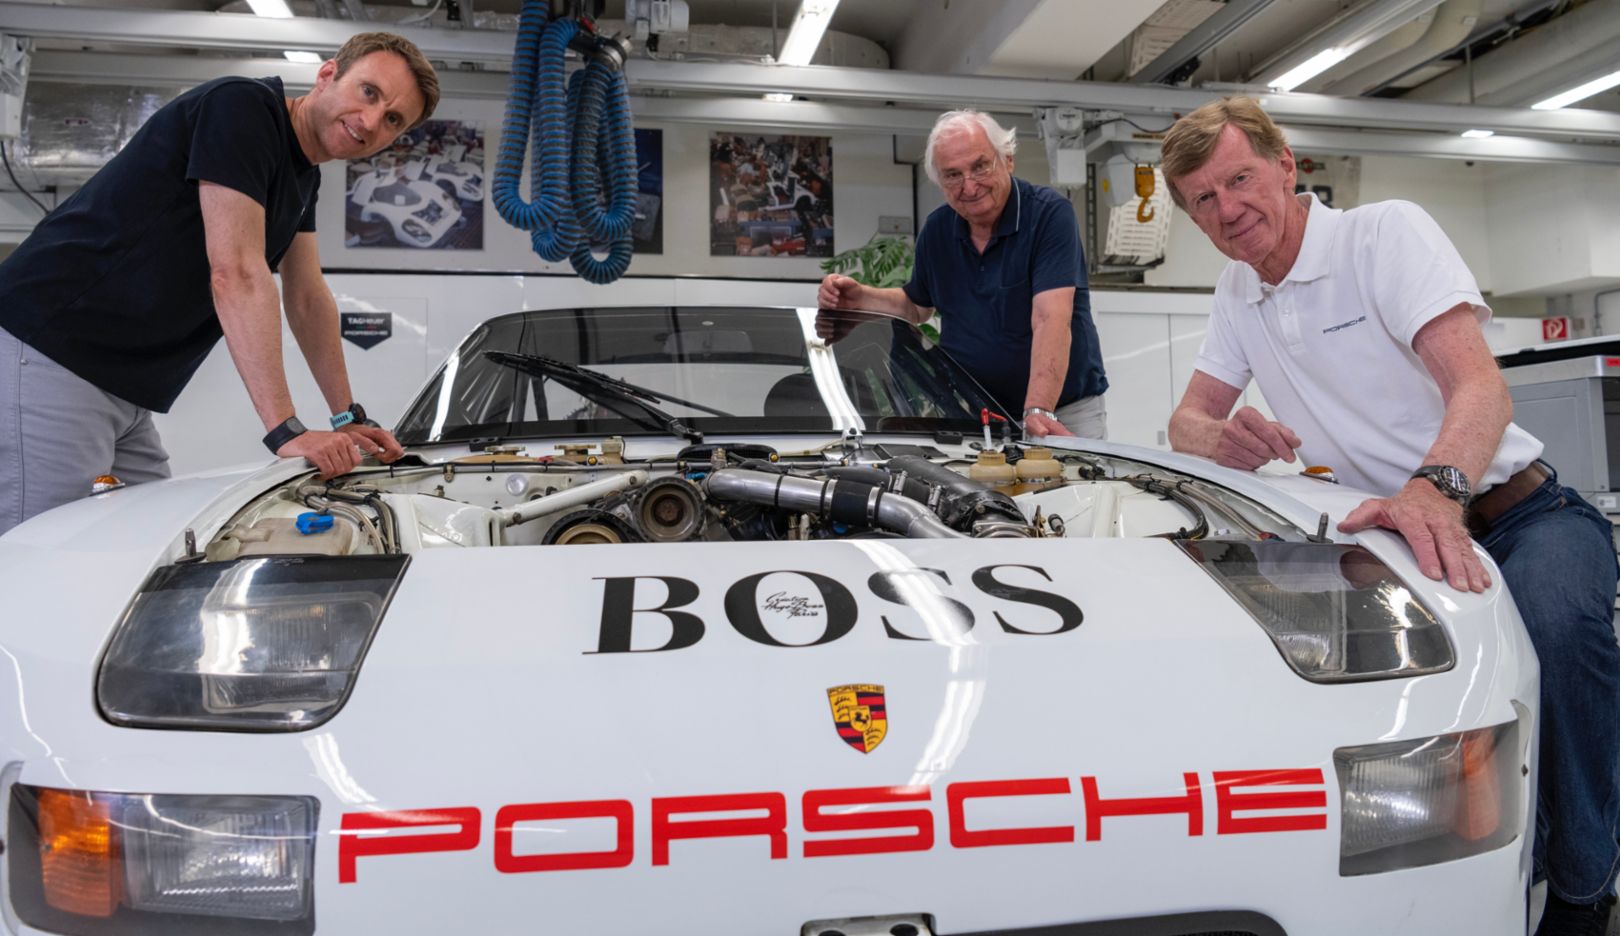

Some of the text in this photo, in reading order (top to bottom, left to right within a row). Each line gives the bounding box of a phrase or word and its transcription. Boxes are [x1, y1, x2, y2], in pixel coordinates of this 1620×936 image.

[1322, 315, 1366, 334] PORSCHE
[582, 564, 1083, 655] BOSS
[339, 768, 1327, 883] PORSCHE
